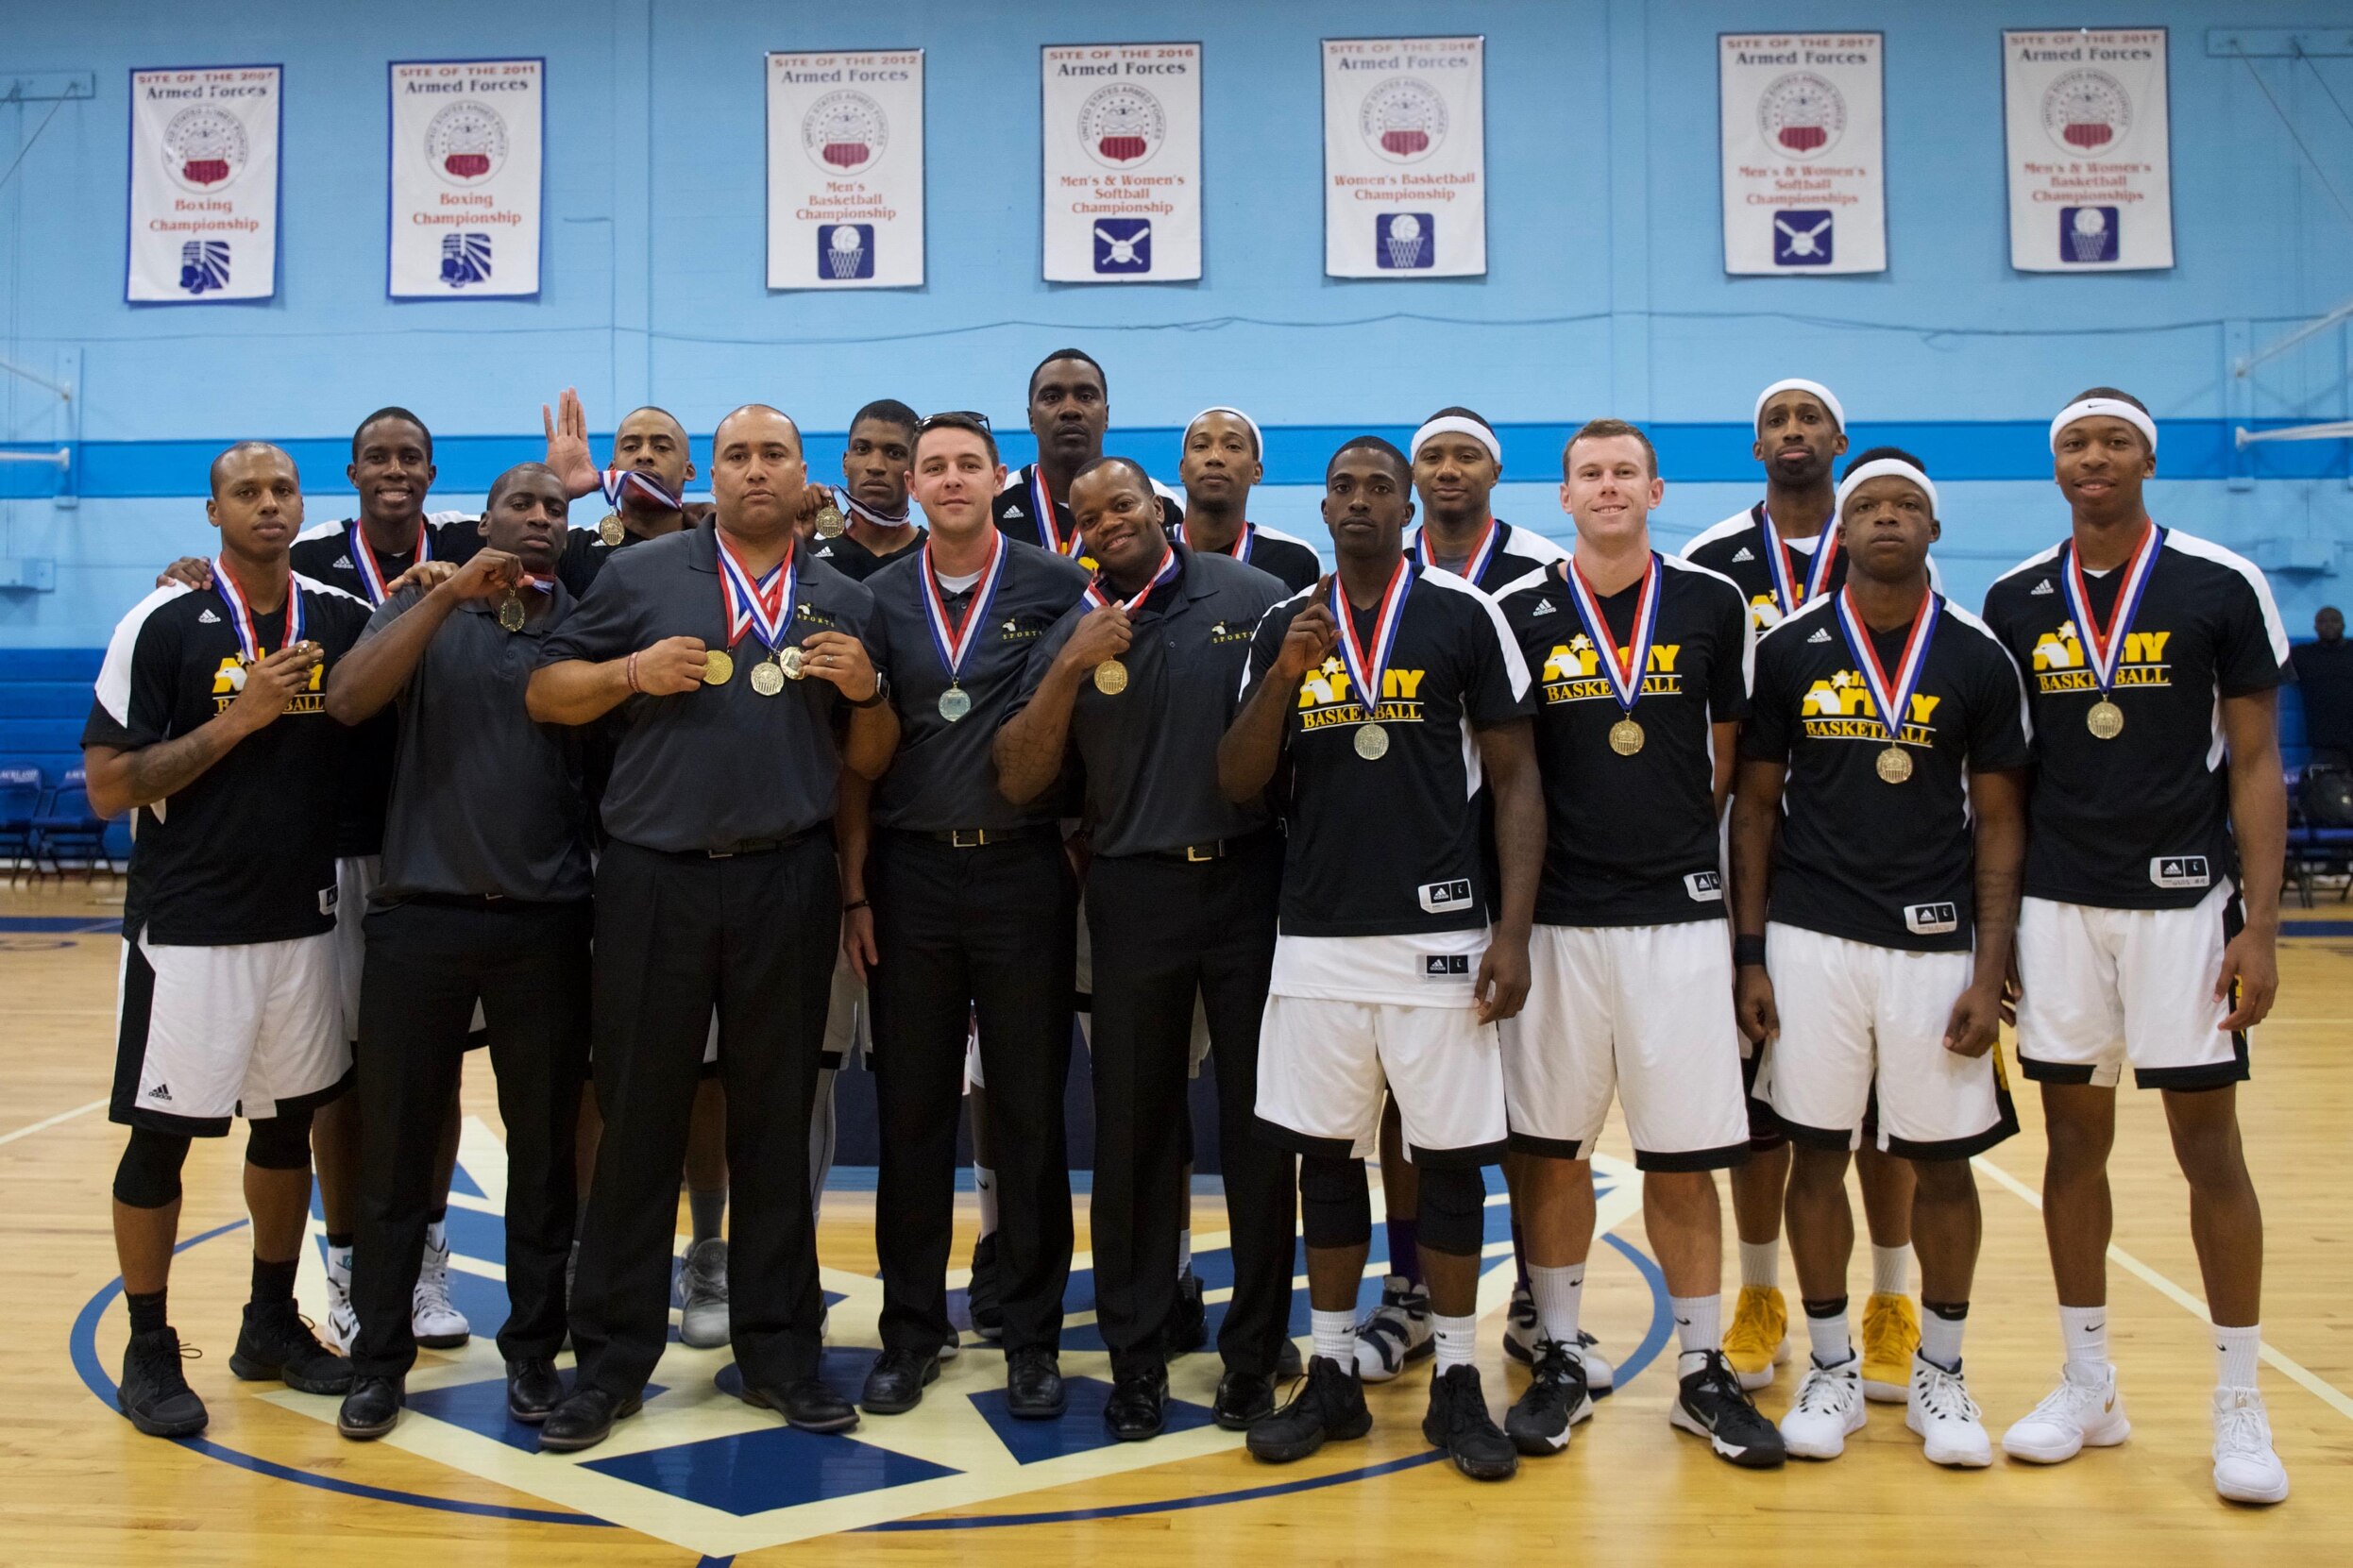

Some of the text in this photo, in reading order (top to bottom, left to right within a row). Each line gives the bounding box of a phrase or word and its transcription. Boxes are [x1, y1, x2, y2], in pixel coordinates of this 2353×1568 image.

[1727, 40, 1762, 49] SITE
[1769, 39, 1791, 49] OF
[1799, 38, 1830, 48] THE
[2010, 36, 2046, 45] SITE
[2052, 35, 2075, 45] OF
[2083, 34, 2115, 44] THE
[1049, 48, 1194, 60] SITE OF THE 2016
[1329, 44, 1365, 55] SITE
[1371, 43, 1394, 54] OF
[1402, 42, 1432, 53] THE
[2019, 47, 2153, 62] Armed Forces
[774, 55, 918, 67] SITE OF THE 2012
[1338, 56, 1469, 71] Armed Forces
[1735, 50, 1868, 65] Armed Forces
[399, 64, 535, 76] SITE OF THE 2011
[781, 68, 909, 84] Armed Forces
[1058, 61, 1187, 76] Armed Forces
[138, 75, 170, 84] SITE
[177, 74, 196, 83] OF
[205, 72, 234, 82] THE
[145, 84, 267, 100] Armed Forces
[405, 78, 529, 94] Armed Forces
[1739, 165, 1866, 177] Men's & Women's
[2024, 161, 2152, 174] Men's & Women's
[1060, 175, 1185, 187] Men's & Women's
[1334, 172, 1476, 186] Women's Basketball
[1774, 178, 1832, 191] Softball
[2050, 175, 2127, 188] Basketball
[825, 181, 866, 193] Men's
[1094, 188, 1150, 200] Softball
[440, 193, 494, 209] Boxing
[808, 194, 883, 206] Basketball
[1354, 187, 1456, 203] Championship
[1746, 192, 1858, 207] Championships
[2032, 189, 2144, 204] Championships
[175, 198, 233, 214] Boxing
[1072, 201, 1174, 216] Championship
[413, 211, 522, 228] Championship
[796, 207, 896, 222] Championship
[149, 217, 260, 233] Championship
[2040, 667, 2169, 691] BASKEBALL
[1547, 677, 1680, 702] BASKEALL
[1805, 720, 1932, 745] BASKETALL
